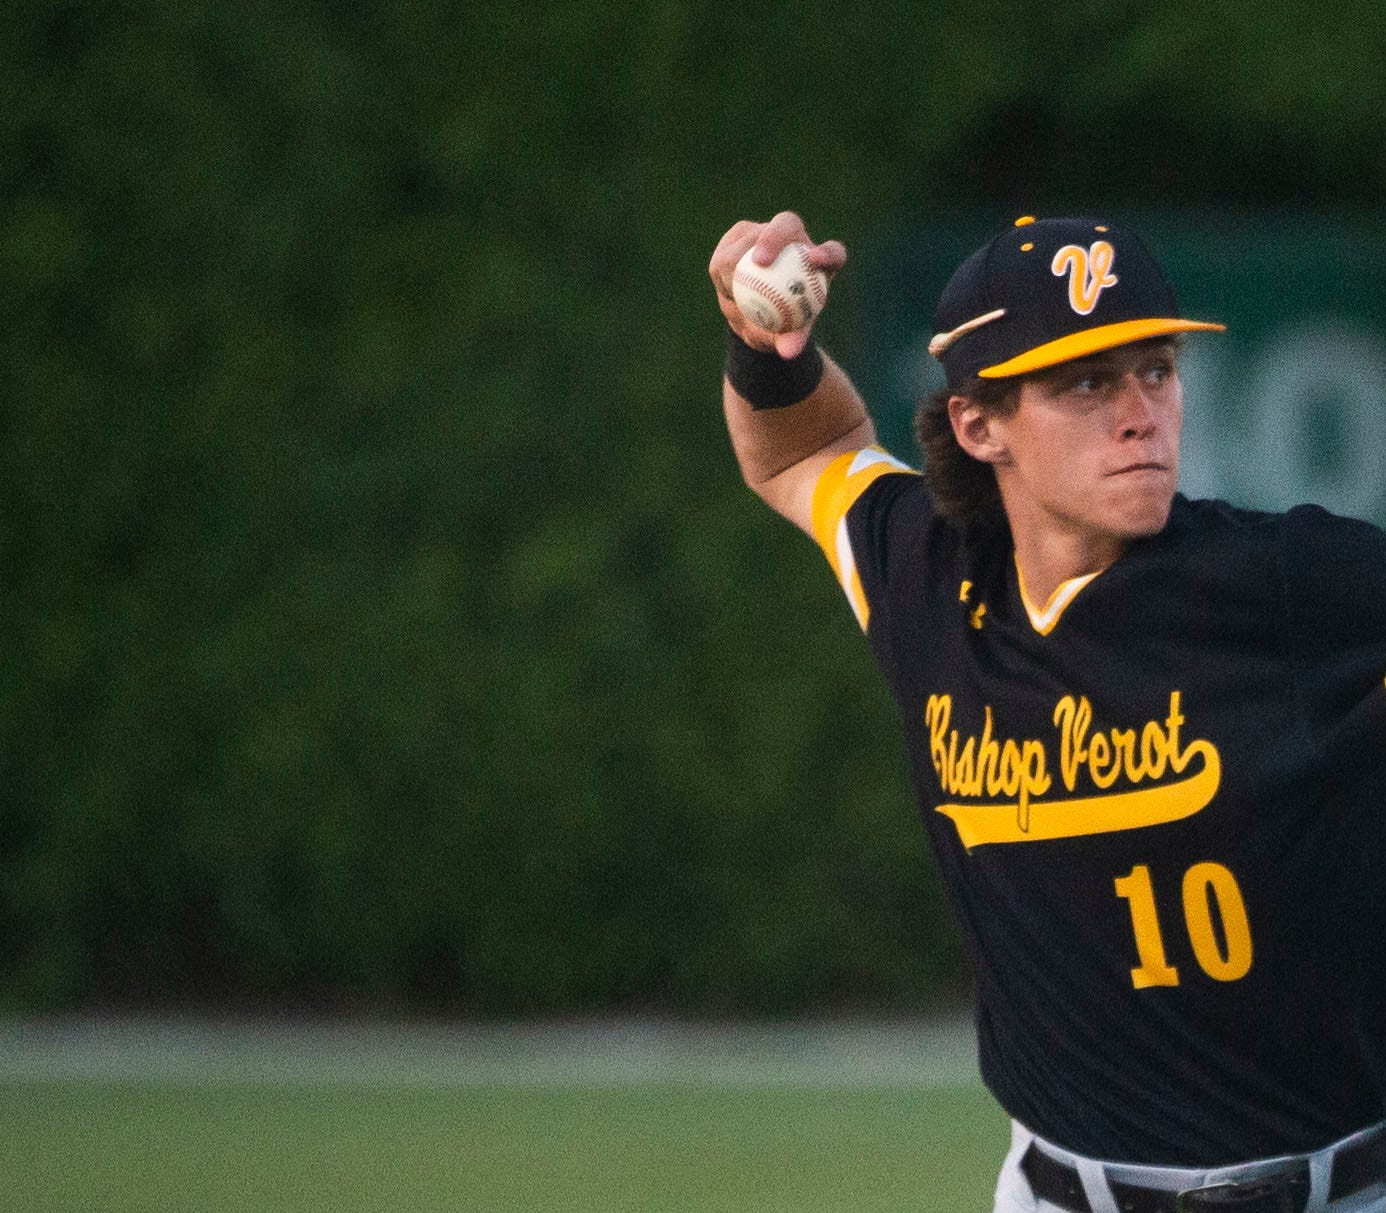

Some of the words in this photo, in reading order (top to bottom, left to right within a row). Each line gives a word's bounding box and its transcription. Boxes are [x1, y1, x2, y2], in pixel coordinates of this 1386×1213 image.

[1051, 240, 1119, 316] V
[924, 693, 1052, 834] Bishop
[1052, 690, 1194, 792] Verot
[1113, 861, 1254, 990] 10
